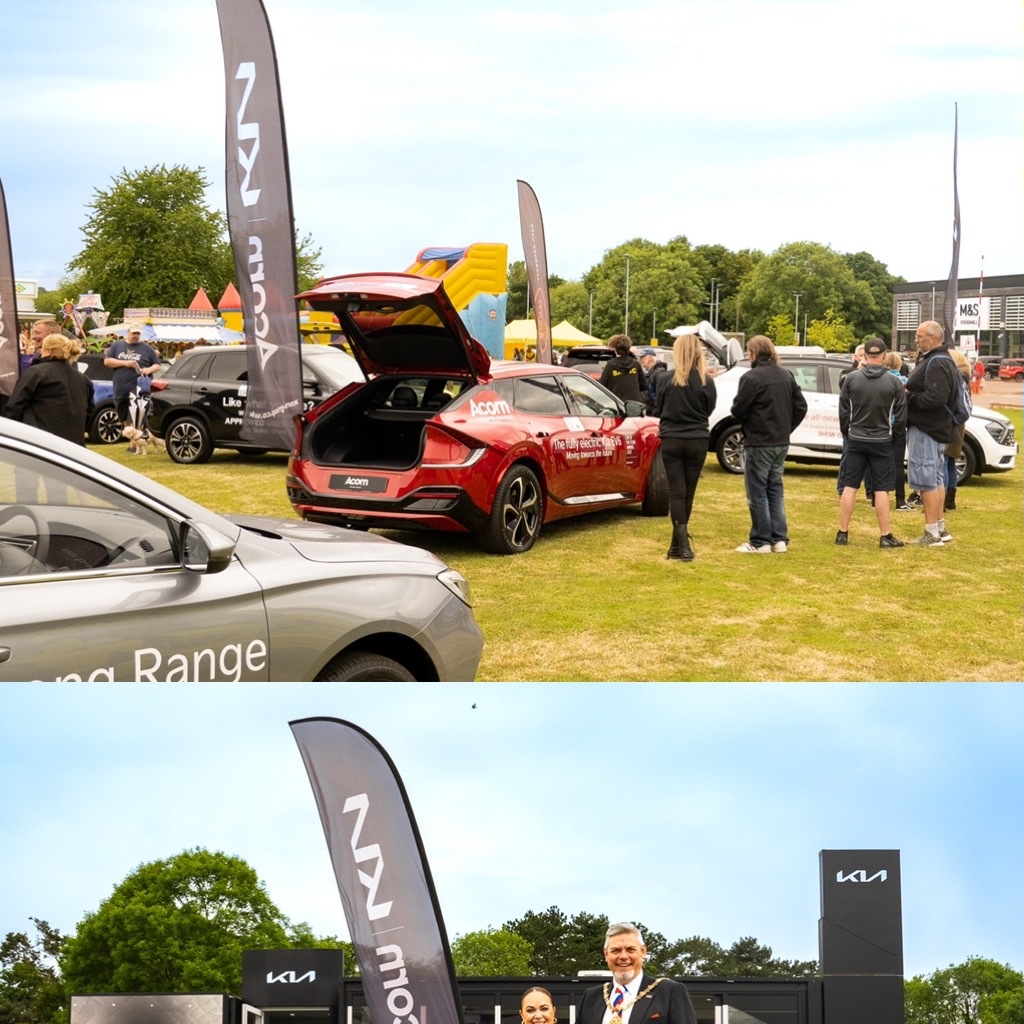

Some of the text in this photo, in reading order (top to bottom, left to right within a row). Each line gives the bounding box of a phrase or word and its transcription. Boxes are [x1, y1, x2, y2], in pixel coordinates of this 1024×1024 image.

[960, 304, 979, 316] M&S
[223, 397, 242, 407] Like
[469, 399, 511, 417] Acorn
[554, 437, 565, 450] The
[345, 476, 369, 486] Acorn
[134, 639, 267, 682] Range
[836, 869, 888, 883] KIA
[266, 970, 316, 983] KIA
